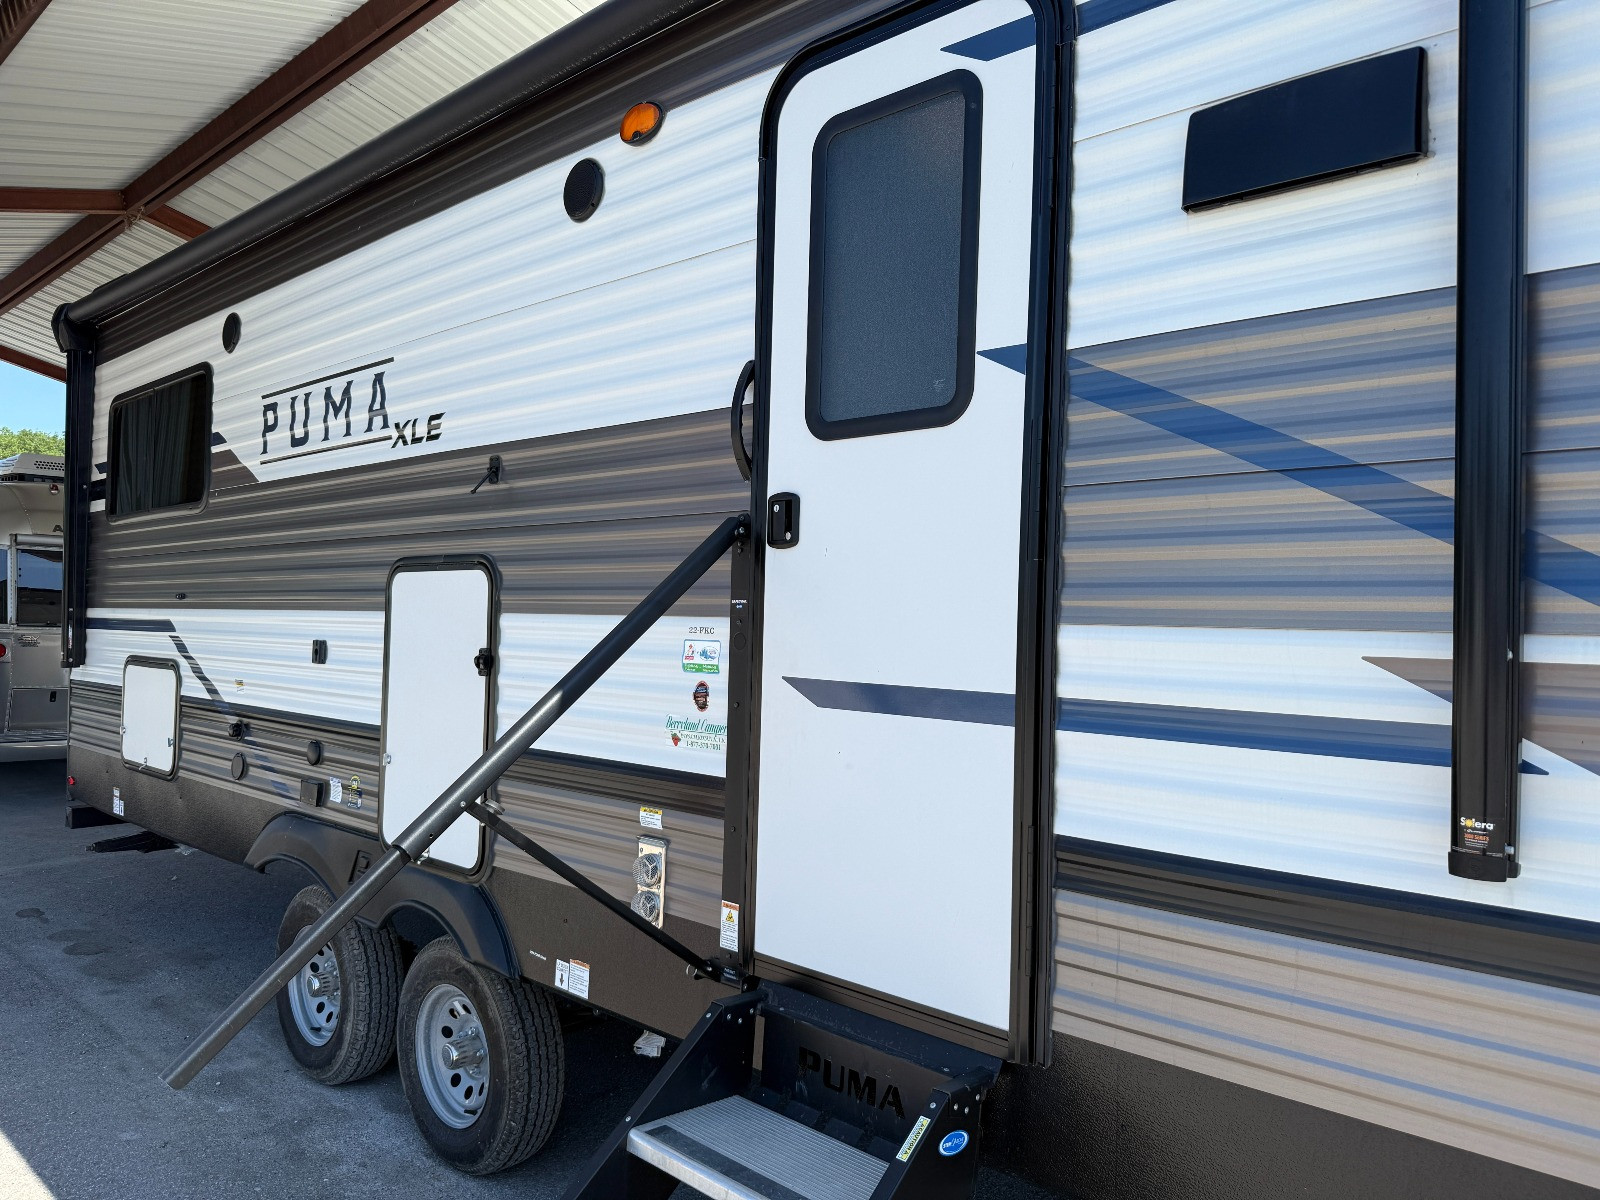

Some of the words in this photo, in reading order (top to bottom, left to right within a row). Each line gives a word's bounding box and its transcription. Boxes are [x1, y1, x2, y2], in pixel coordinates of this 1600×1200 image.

[260, 371, 390, 455] PUMA
[391, 412, 446, 448] XLE
[666, 716, 700, 731] Berryland
[701, 719, 728, 736] Camper
[1460, 816, 1494, 830] Solera
[799, 1046, 905, 1119] PUMA
